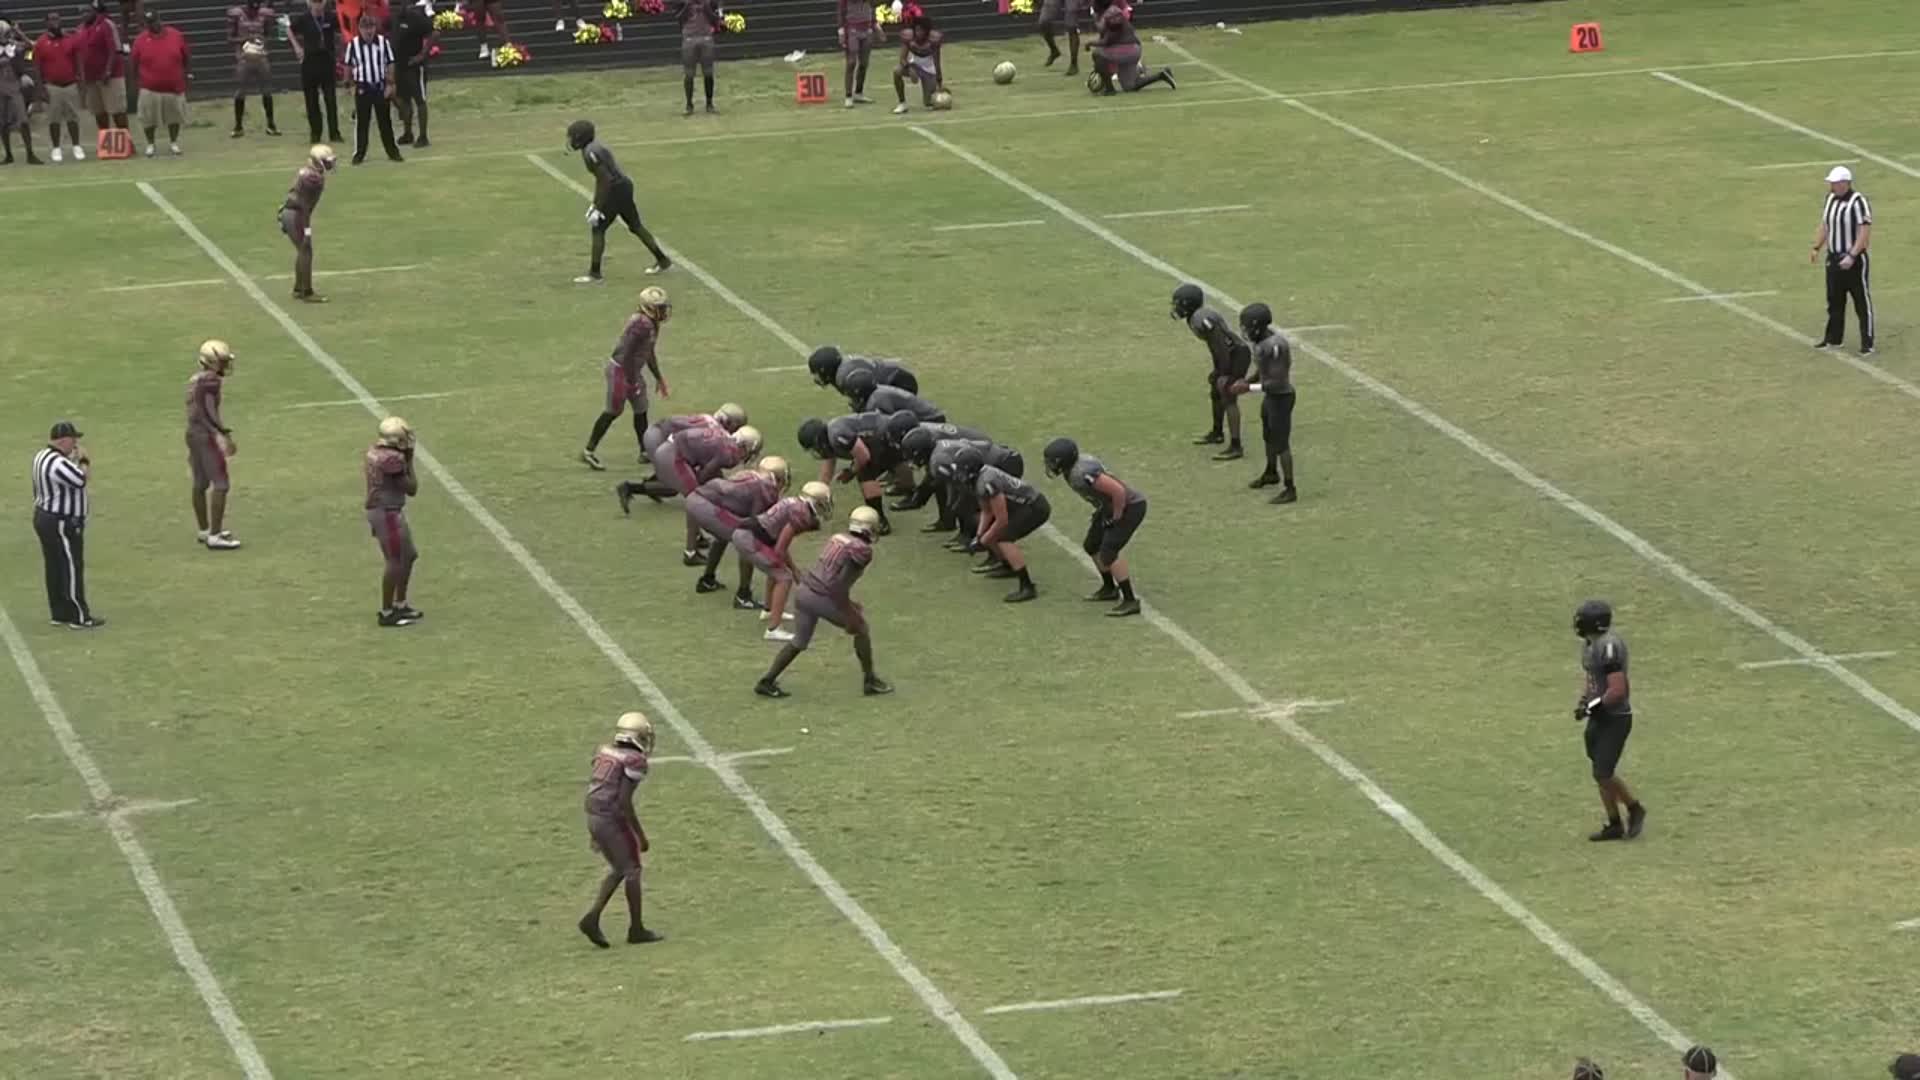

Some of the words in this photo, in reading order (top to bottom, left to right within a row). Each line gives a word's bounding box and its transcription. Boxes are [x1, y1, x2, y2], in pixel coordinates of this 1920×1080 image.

[1577, 27, 1599, 49] 20
[800, 75, 824, 97] 30
[101, 131, 125, 154] 40
